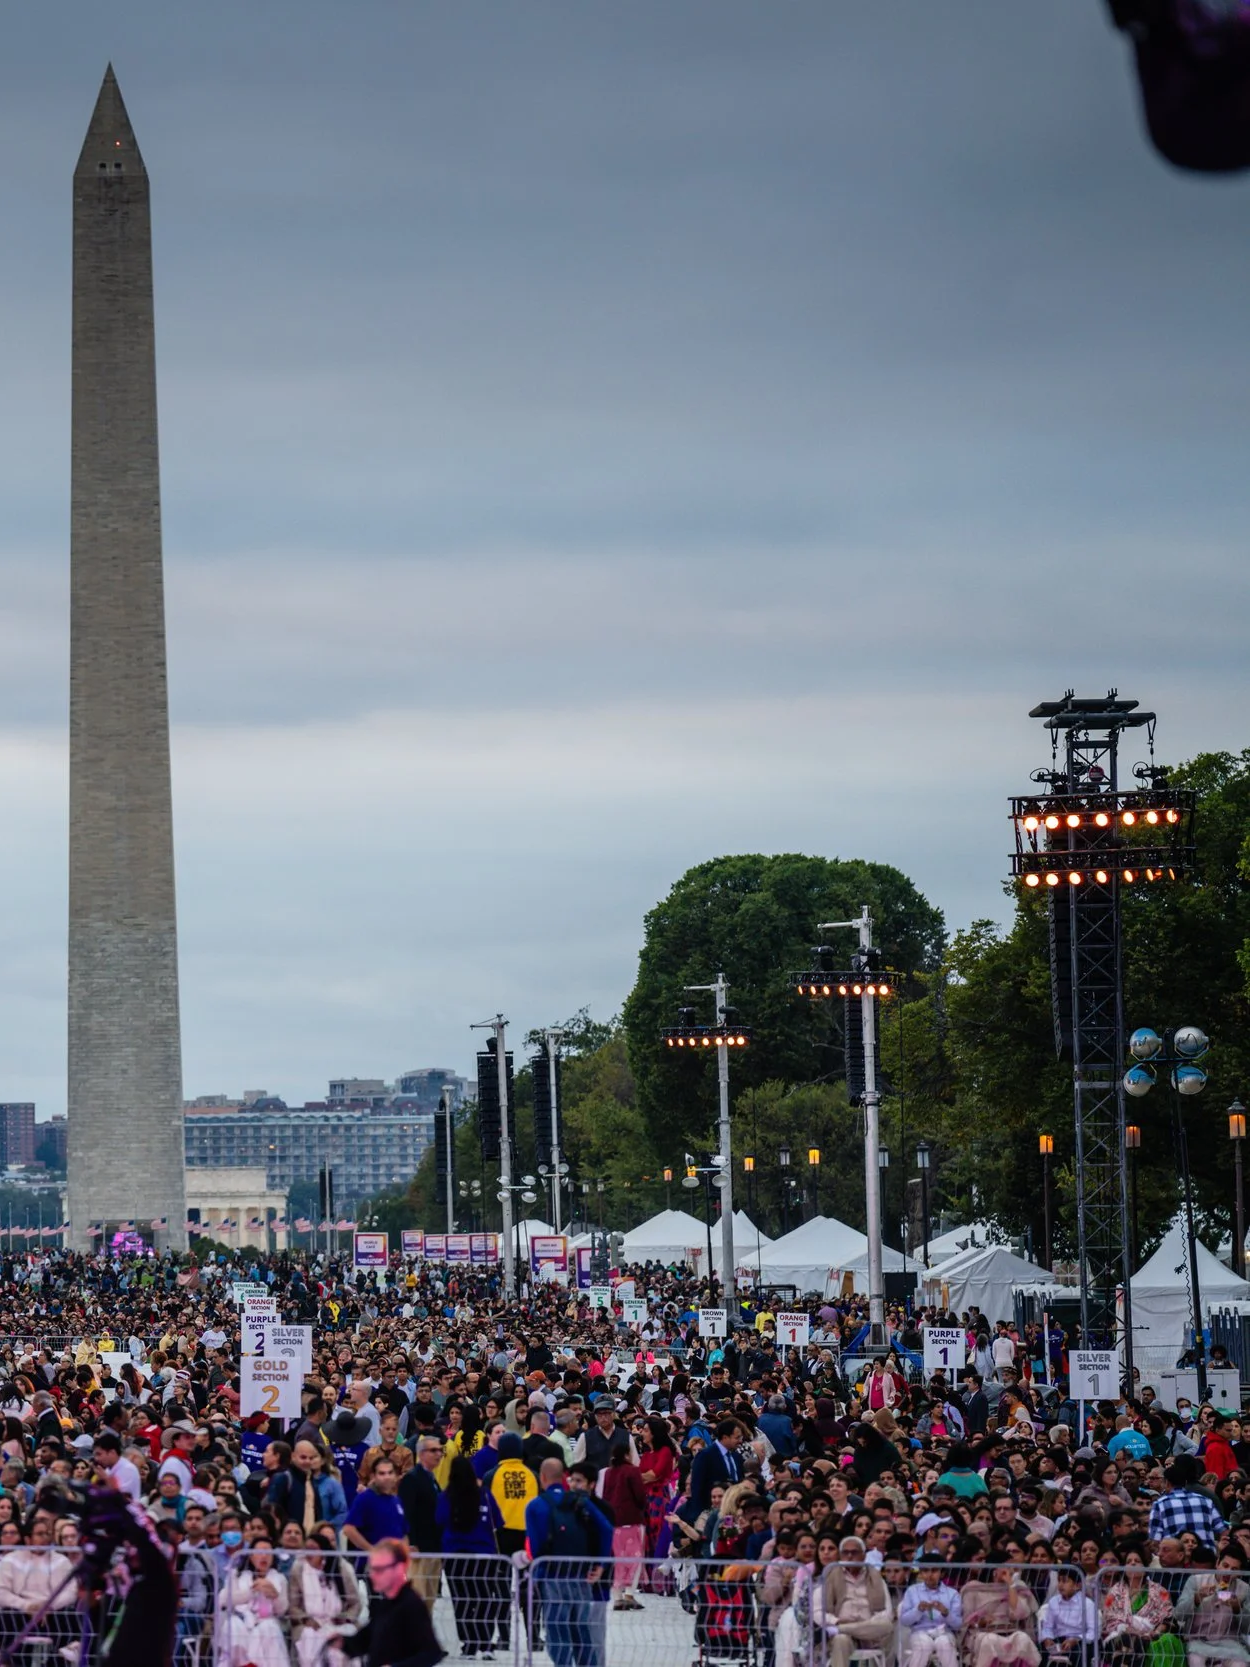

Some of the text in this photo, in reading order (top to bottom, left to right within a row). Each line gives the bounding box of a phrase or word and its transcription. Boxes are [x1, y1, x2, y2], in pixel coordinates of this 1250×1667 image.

[597, 1297, 604, 1307] 5
[632, 1309, 638, 1320] 1
[272, 1328, 305, 1337] SILVER
[709, 1322, 716, 1334] 1
[789, 1328, 797, 1342] 1
[928, 1330, 961, 1338] PURPLE
[255, 1333, 265, 1350] 2
[939, 1347, 948, 1365] 1
[1077, 1353, 1111, 1362] SILVER
[253, 1361, 288, 1371] GOLD
[1087, 1374, 1100, 1396] 1
[261, 1385, 280, 1412] 2
[503, 1471, 527, 1480] CSC
[504, 1480, 527, 1490] EVENT
[504, 1490, 527, 1499] STAFF
